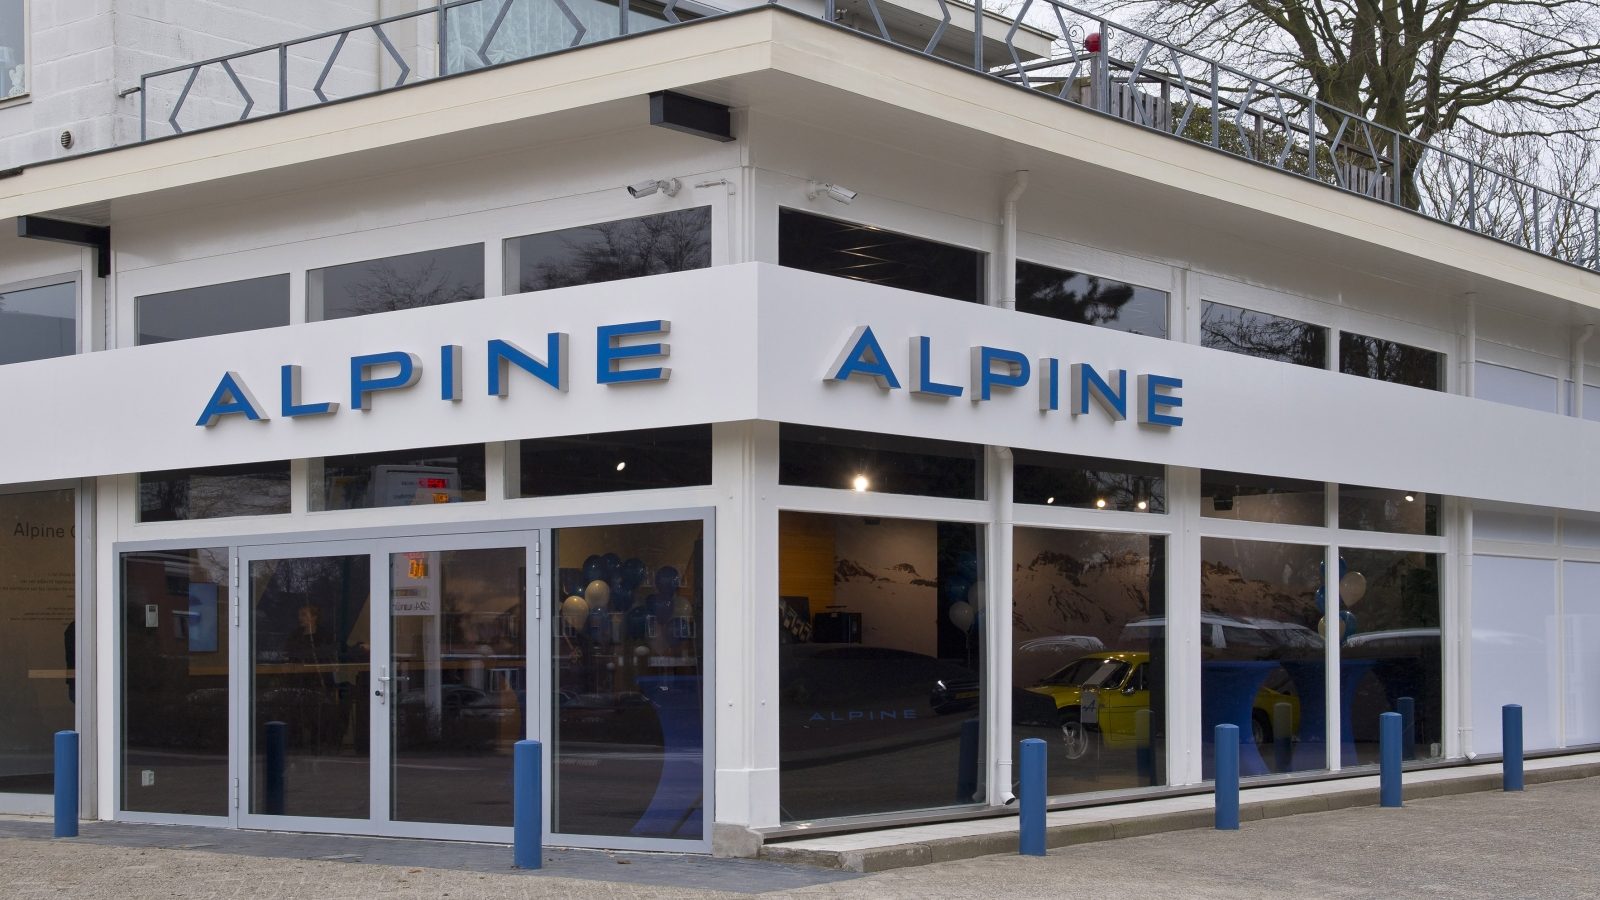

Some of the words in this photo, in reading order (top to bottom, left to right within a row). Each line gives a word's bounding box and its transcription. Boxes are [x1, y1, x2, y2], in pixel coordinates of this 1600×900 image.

[195, 319, 671, 427] ALPINE
[822, 325, 1184, 426] ALPINE
[13, 522, 65, 540] Alpine
[809, 708, 918, 721] ALPINE
